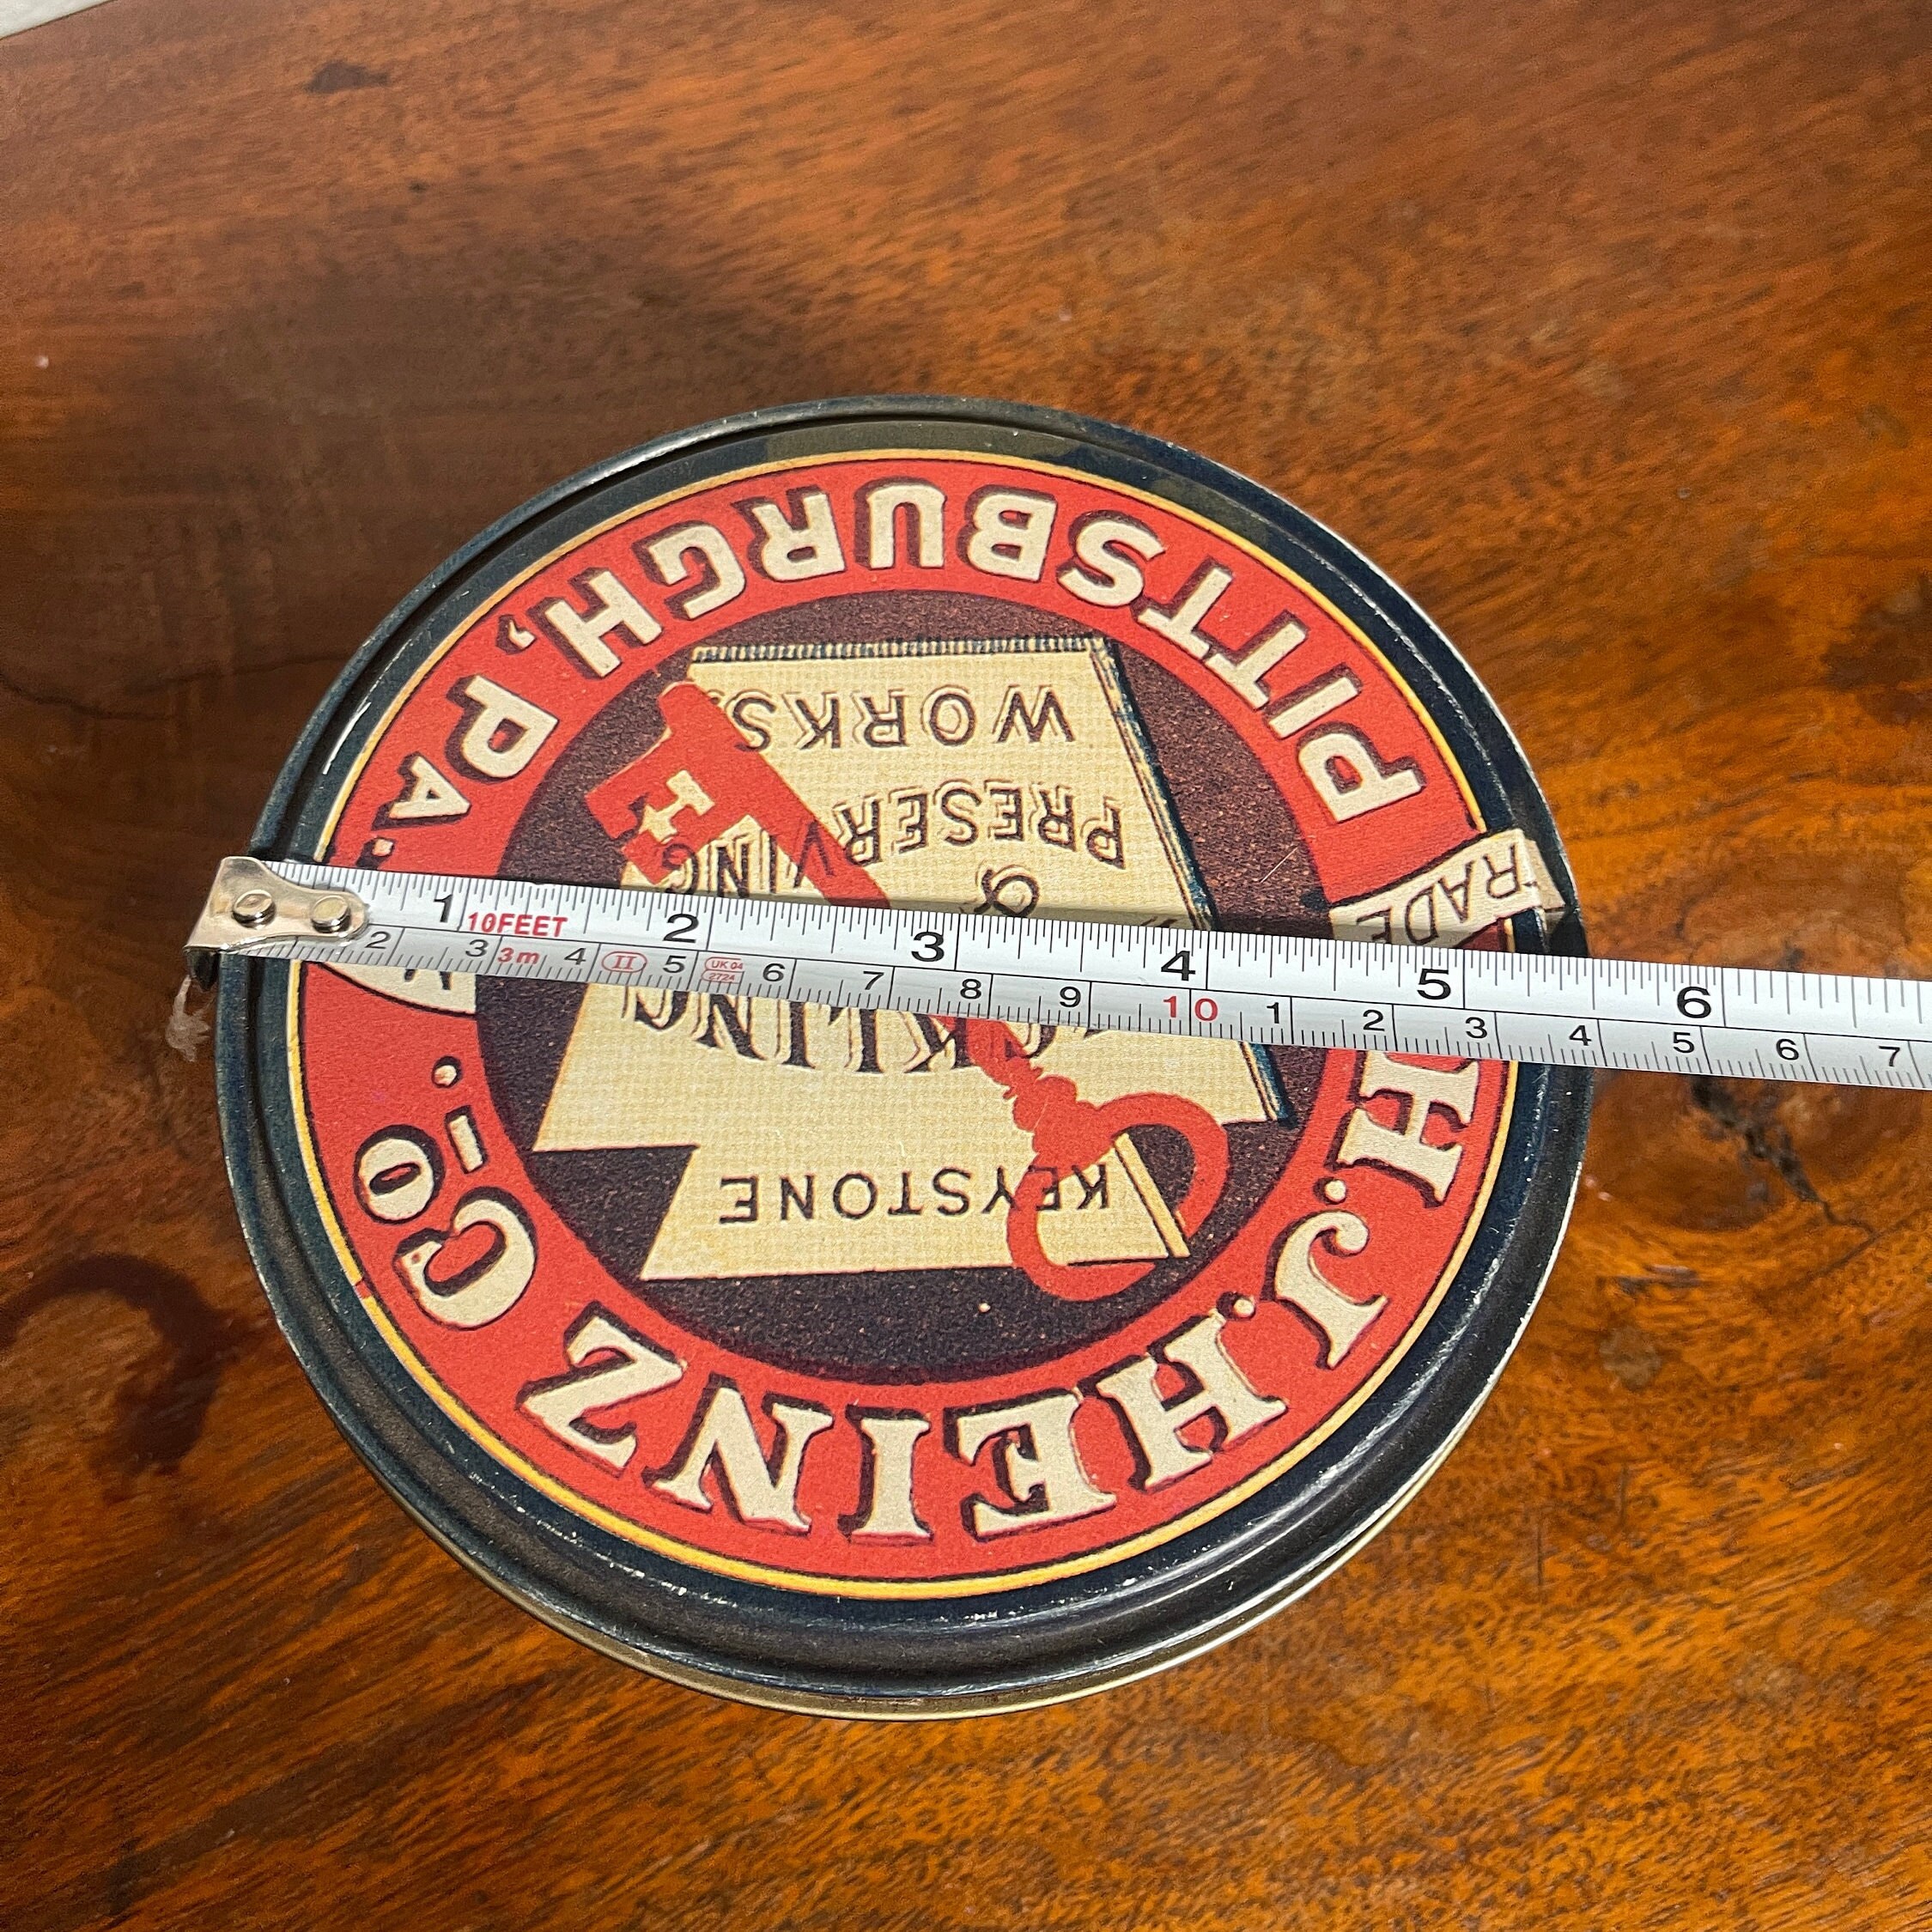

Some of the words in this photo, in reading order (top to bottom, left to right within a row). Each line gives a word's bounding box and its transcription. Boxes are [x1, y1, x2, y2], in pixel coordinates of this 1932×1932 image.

[495, 477, 1429, 826] PITTSBURGH,
[356, 671, 560, 869] PA.
[730, 683, 1077, 752] WORKS
[434, 894, 454, 923] 1
[663, 913, 701, 943] 2
[910, 932, 945, 963] 3
[1160, 951, 1196, 981] 4
[1416, 969, 1452, 1000] 5
[1676, 986, 1712, 1019] 6
[467, 911, 568, 939] 10FEET
[1355, 845, 1523, 945] RADE
[365, 932, 392, 951] 2
[465, 940, 488, 959] 3
[562, 947, 586, 967] 4
[662, 955, 687, 974] 5
[762, 963, 785, 982] 6
[862, 970, 885, 991] 7
[959, 977, 983, 999] 8
[1058, 986, 1082, 1007] 9
[1163, 997, 1218, 1022] 10
[1267, 1002, 1281, 1024] 1
[1362, 1010, 1385, 1032] 2
[1465, 1018, 1488, 1039] 3
[1569, 1025, 1592, 1047] 4
[1672, 1033, 1696, 1054] 5
[1776, 1039, 1800, 1061] 6
[1878, 1046, 1903, 1068] 7
[719, 1163, 1109, 1224] KEYSTONE
[515, 1301, 1288, 1542] HEINZ
